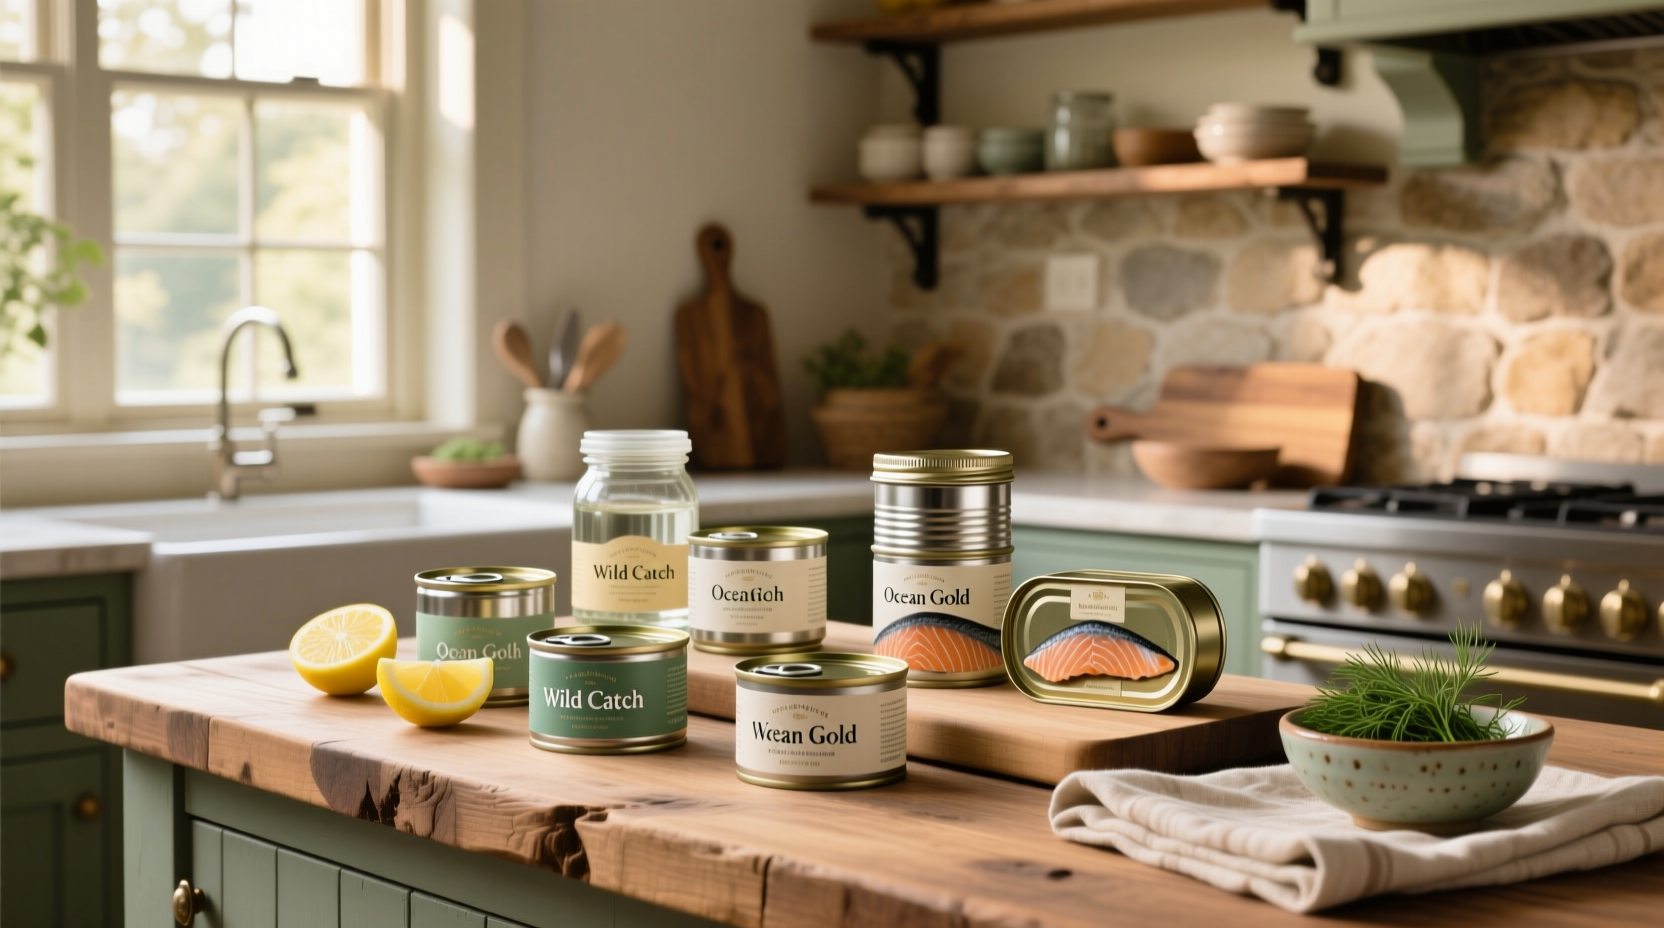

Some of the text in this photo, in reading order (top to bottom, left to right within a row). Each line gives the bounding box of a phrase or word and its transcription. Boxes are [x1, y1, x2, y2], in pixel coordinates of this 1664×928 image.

[593, 563, 628, 581] Wild
[632, 563, 675, 581] Catch
[884, 586, 970, 607] Ocean Gold
[543, 686, 644, 710] Wild Catch
[808, 722, 857, 746] Gold
